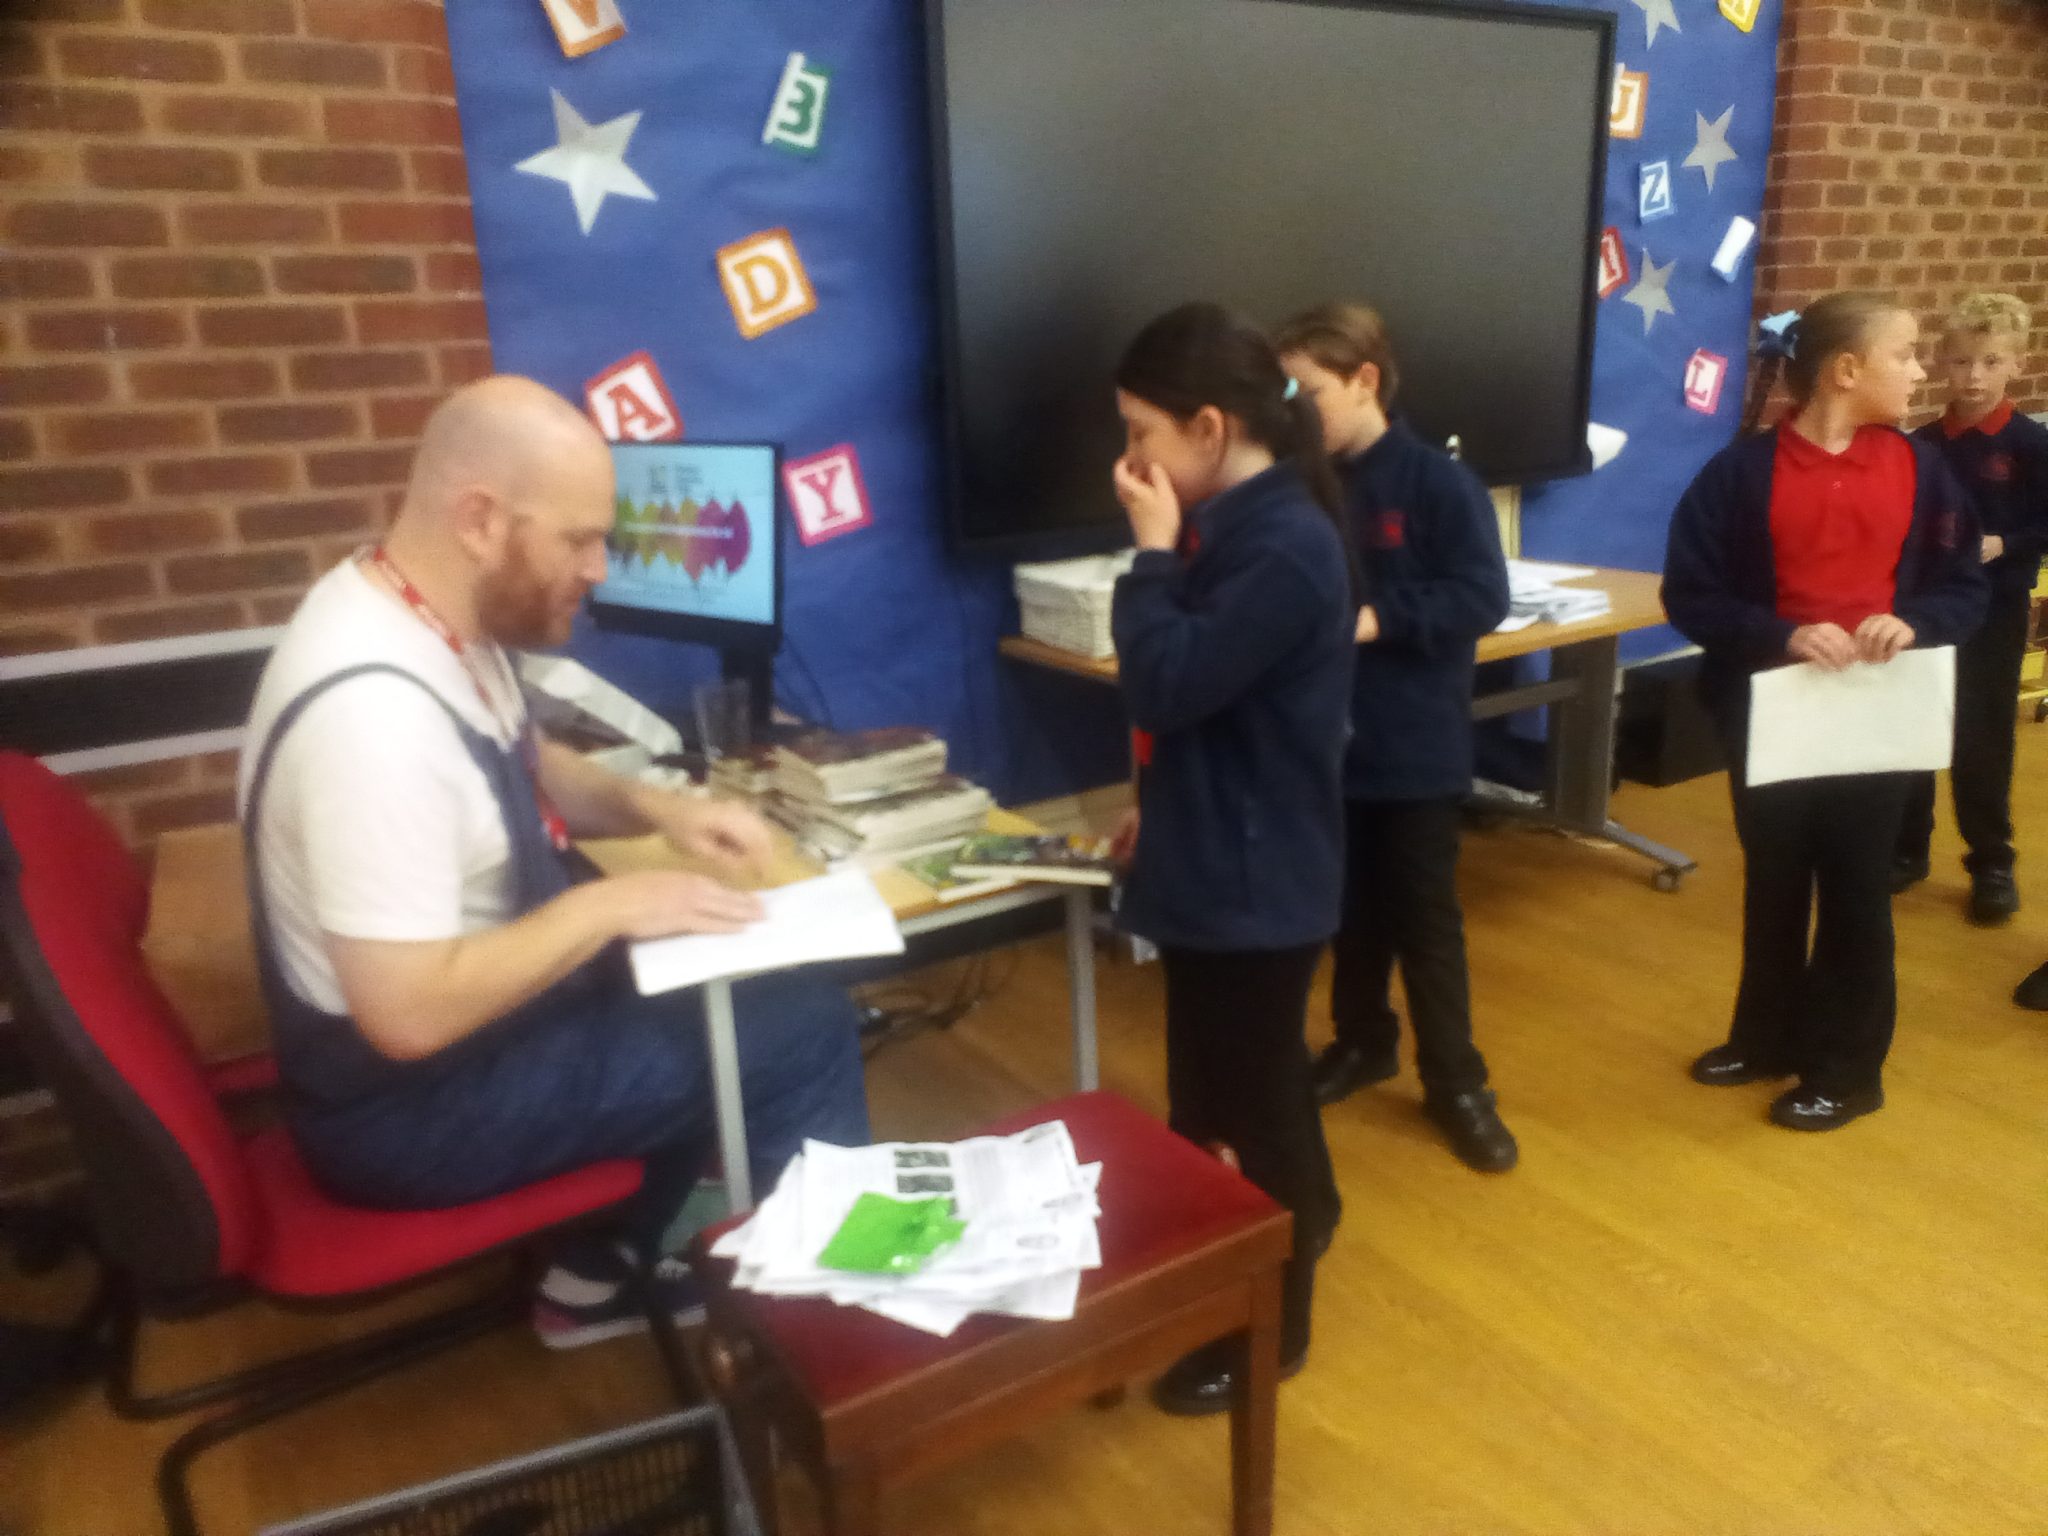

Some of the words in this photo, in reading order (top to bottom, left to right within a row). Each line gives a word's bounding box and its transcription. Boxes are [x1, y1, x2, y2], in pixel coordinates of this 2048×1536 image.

[1641, 166, 1664, 211] Z
[733, 255, 788, 316] D
[1685, 360, 1707, 401] L
[607, 383, 666, 441] A
[799, 464, 843, 521] Y
